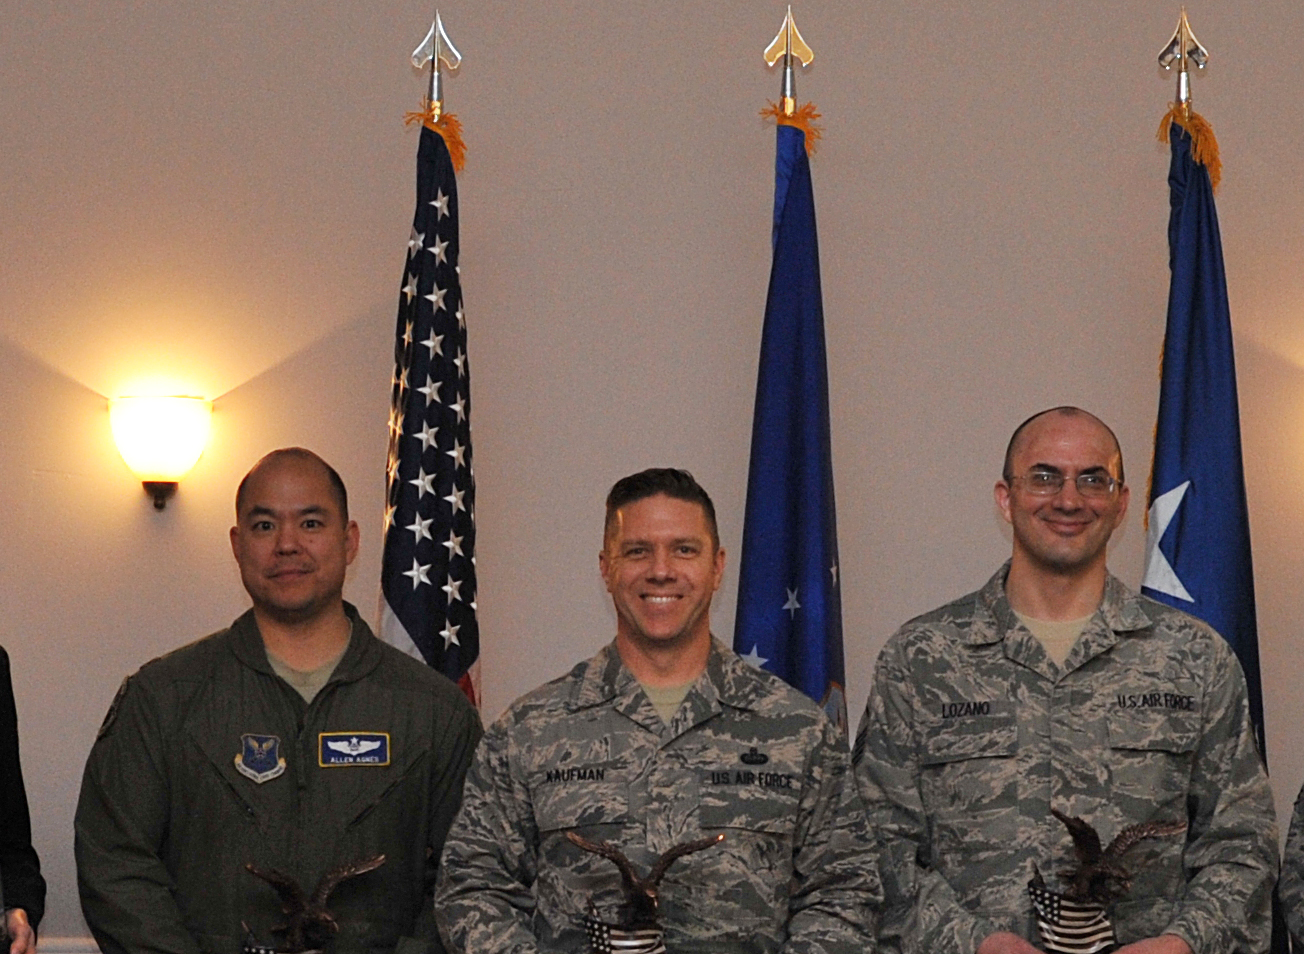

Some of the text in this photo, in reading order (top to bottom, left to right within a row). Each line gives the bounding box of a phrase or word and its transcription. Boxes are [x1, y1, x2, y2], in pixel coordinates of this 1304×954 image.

[942, 701, 990, 719] LOZANO
[1141, 692, 1162, 707] AIR
[1164, 692, 1195, 711] FORCE
[546, 768, 605, 782] KAUFMAN
[736, 771, 755, 785] AIR
[758, 772, 795, 789] FORCE
